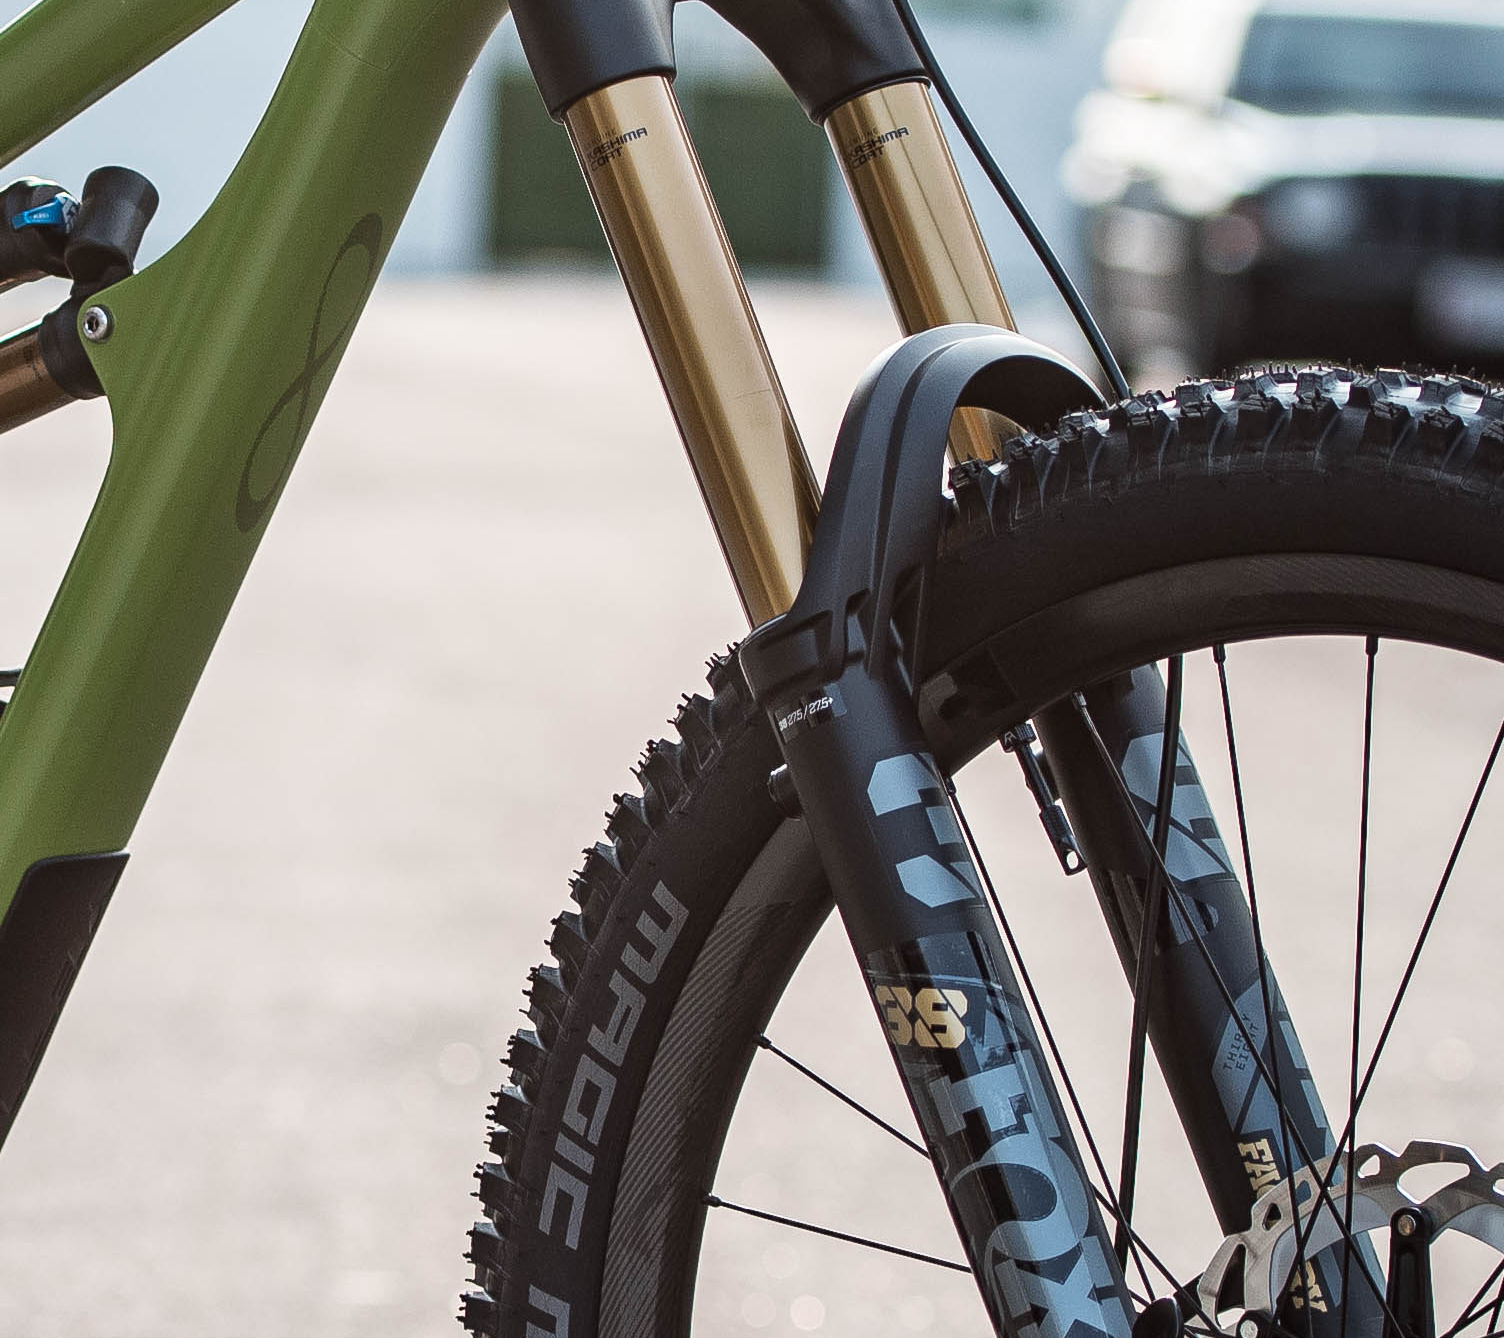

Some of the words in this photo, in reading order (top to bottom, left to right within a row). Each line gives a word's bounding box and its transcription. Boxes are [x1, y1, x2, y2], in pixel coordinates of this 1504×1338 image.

[874, 985, 968, 1049] 38
[1222, 1013, 1251, 1072] THIRY
[538, 879, 690, 1251] MAGIC
